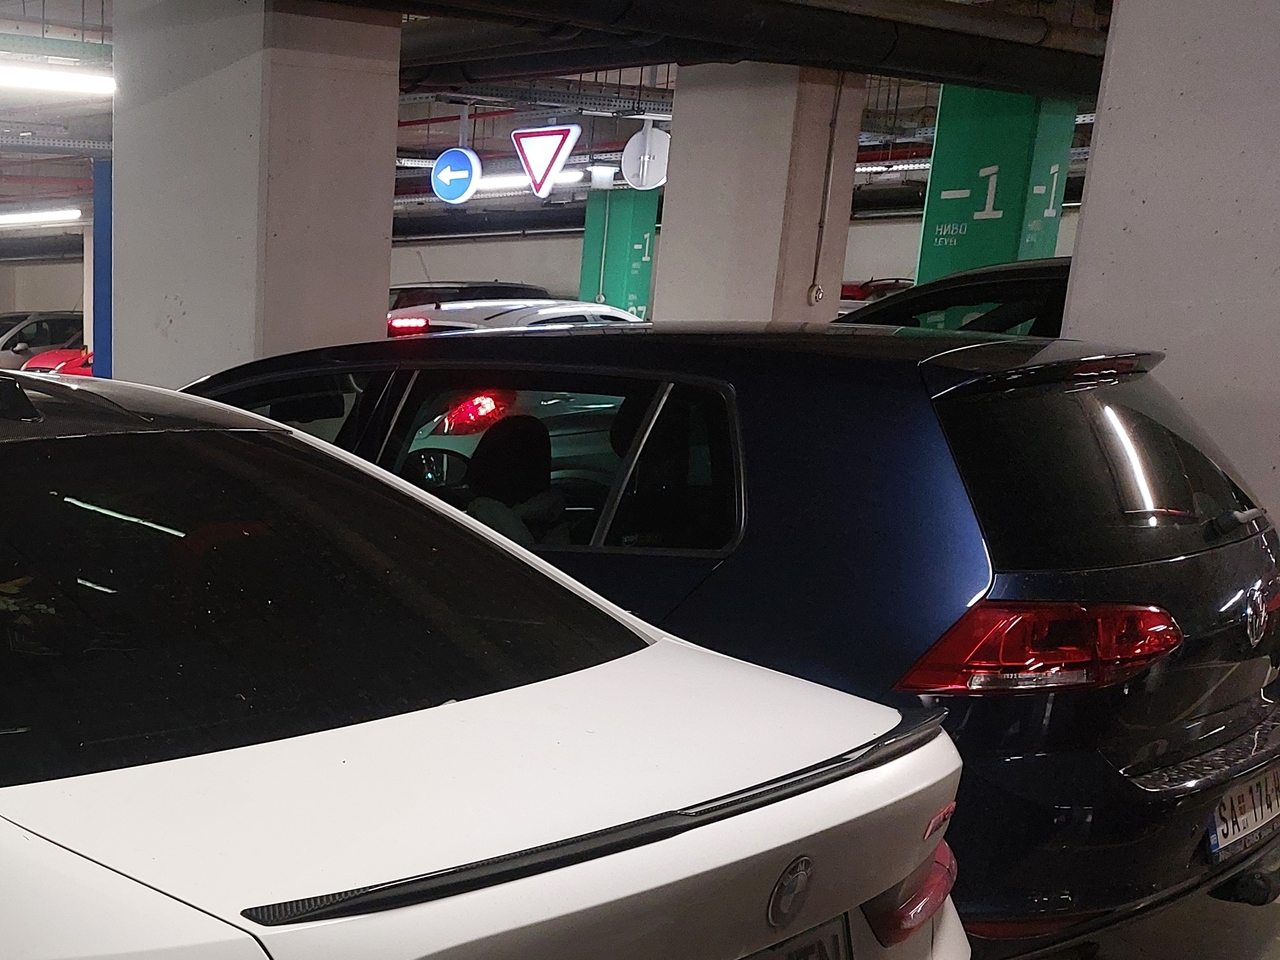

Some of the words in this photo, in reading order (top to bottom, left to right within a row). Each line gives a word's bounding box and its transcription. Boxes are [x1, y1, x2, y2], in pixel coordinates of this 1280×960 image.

[940, 164, 1004, 220] -1
[1033, 163, 1060, 218] -1
[633, 232, 651, 262] -1
[934, 222, 969, 236] НИВО
[1218, 796, 1241, 840] SA
